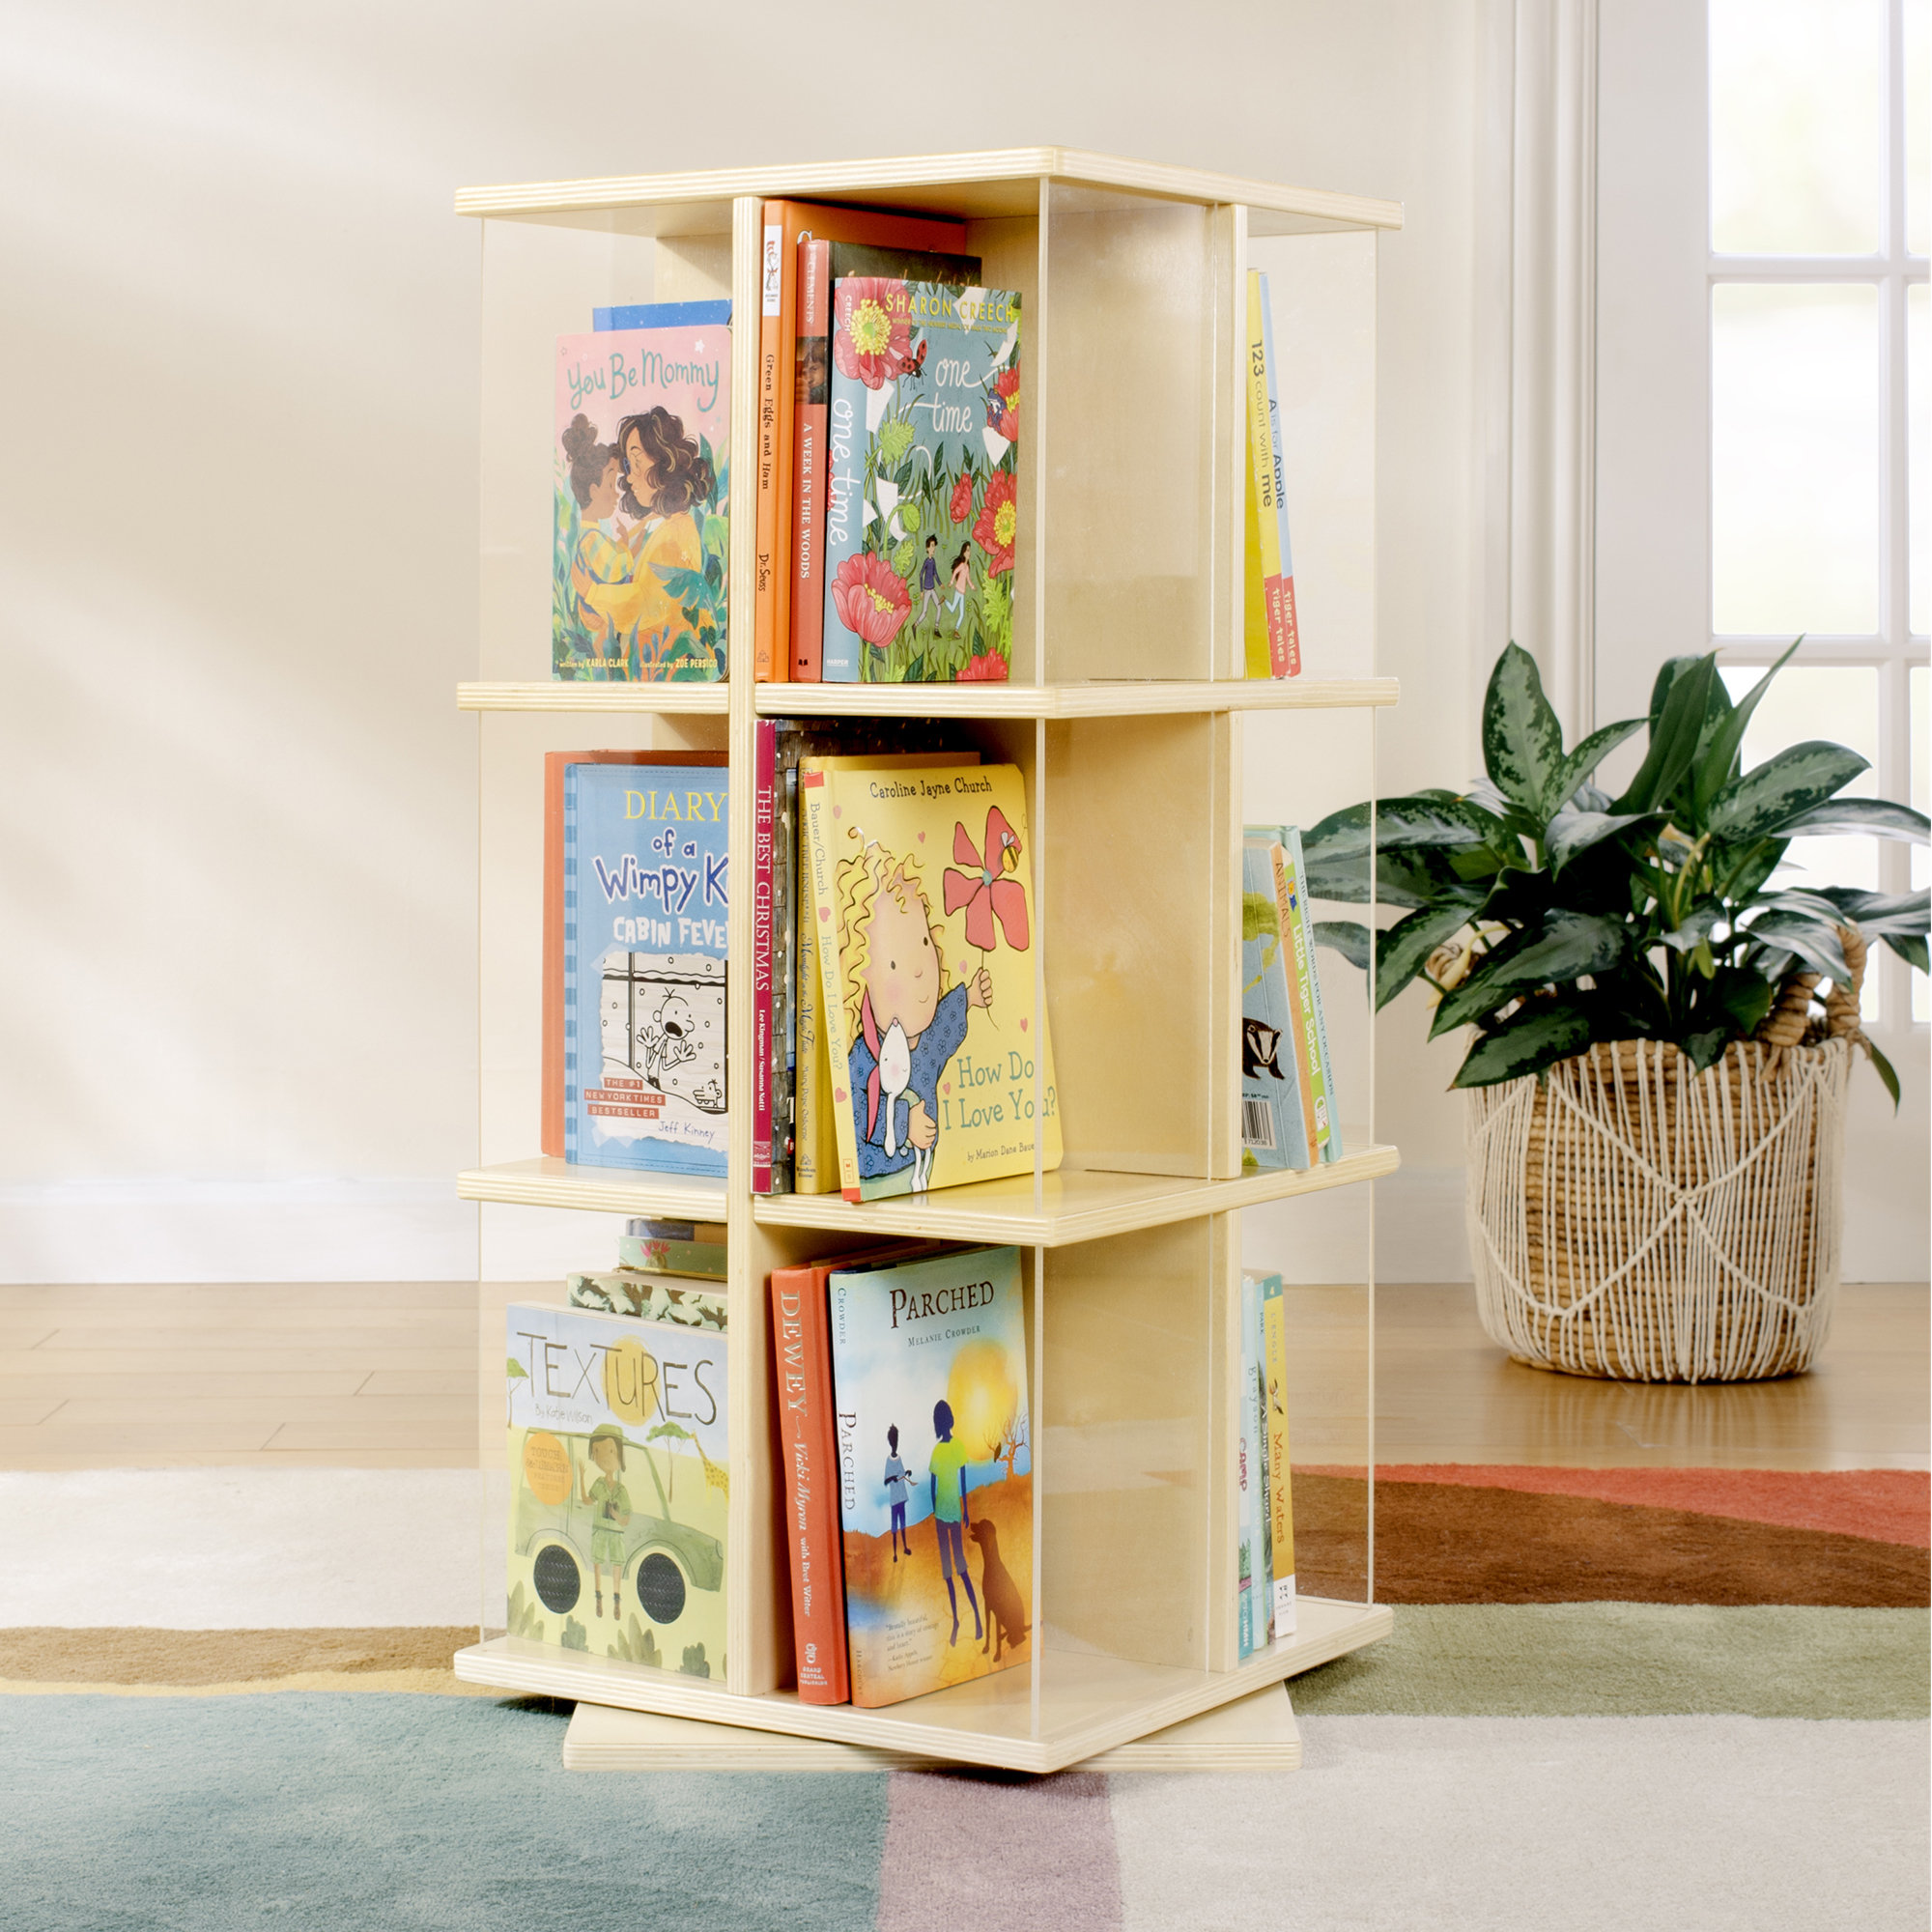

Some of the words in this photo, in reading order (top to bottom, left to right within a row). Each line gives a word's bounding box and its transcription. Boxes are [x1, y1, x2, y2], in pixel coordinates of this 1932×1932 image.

[844, 294, 853, 332] CREECH
[885, 293, 952, 318] SHARON
[959, 300, 1013, 323] CREECH
[765, 354, 775, 391] Green
[935, 358, 987, 387] one
[1251, 340, 1264, 377] 123
[567, 361, 606, 411] You
[609, 353, 639, 400] Be
[641, 349, 720, 412] Mommy
[763, 398, 774, 429] Eggs
[915, 392, 973, 433] time
[1255, 381, 1265, 427] count
[1268, 398, 1277, 413] A
[763, 434, 772, 457] and
[803, 423, 812, 433] A
[832, 398, 854, 463] one
[803, 437, 812, 474] WEEK
[1259, 432, 1269, 469] with
[762, 463, 772, 490] Ham
[802, 479, 810, 494] IN
[1262, 474, 1272, 508] me
[1272, 454, 1285, 509] Apple
[801, 497, 810, 525] THE
[829, 468, 861, 547] time
[800, 529, 810, 579] WOODS
[758, 568, 771, 592] Seuss
[1272, 587, 1281, 624] tiger
[1284, 590, 1293, 627] tiger
[585, 658, 607, 668] KARLA
[608, 658, 629, 668] CLARK
[690, 658, 719, 668] PERSICO
[1276, 627, 1285, 663] tales
[1288, 630, 1297, 666] tales
[623, 790, 729, 822] DIARY
[757, 785, 772, 824] THE
[869, 781, 917, 799] Caroline
[920, 780, 952, 800] Jayne
[953, 776, 992, 793] Church
[652, 827, 675, 858] of
[682, 841, 696, 858] a
[756, 832, 772, 873] BEST
[810, 803, 828, 895] Bauer/Church
[593, 857, 698, 914] Wimpy
[1275, 862, 1292, 938] ANIMALS
[612, 917, 671, 946] CABIN
[677, 918, 729, 948] FEVE
[755, 881, 771, 991] CHRISTMAS
[821, 935, 833, 966] How
[1293, 923, 1306, 971] Little
[824, 971, 835, 988] Do
[1299, 971, 1312, 1014] Tiger
[827, 1005, 838, 1034] Love
[757, 1023, 766, 1057] Kingman
[831, 1038, 843, 1069] You?
[1305, 1018, 1321, 1076] School
[607, 1078, 624, 1087] THE
[957, 1056, 1002, 1089] How
[1008, 1051, 1035, 1081] Do
[1321, 1036, 1335, 1095] OCCASION
[585, 1091, 605, 1099] NEW
[607, 1093, 631, 1101] YORK
[634, 1094, 663, 1103] TIMES
[591, 1106, 656, 1118] BESTSELLER
[942, 1099, 952, 1130] I
[958, 1097, 1004, 1128] Love
[658, 1121, 679, 1133] Jeff
[683, 1122, 716, 1144] Kinney
[967, 1151, 975, 1163] by
[976, 1149, 999, 1160] Marion
[1001, 1145, 1017, 1156] Dane
[1019, 1142, 1035, 1152] Baue
[838, 1287, 847, 1345] CROWDER
[890, 1280, 995, 1329] PARCHED
[780, 1290, 808, 1417] DEWEY
[908, 1333, 943, 1347] MELANIE
[945, 1325, 980, 1339] CROWDER
[516, 1332, 717, 1426] TEXTURES
[794, 1441, 810, 1483] Vicki
[838, 1411, 857, 1510] PARCHED
[1238, 1437, 1248, 1492] CAMP
[1262, 1422, 1270, 1470] Single
[1272, 1431, 1283, 1480] Many
[793, 1483, 810, 1531] Myron
[1262, 1475, 1271, 1523] Shard
[1275, 1486, 1286, 1545] Waters
[800, 1537, 810, 1559] with
[801, 1561, 810, 1582] Bret
[803, 1585, 812, 1617] Witter
